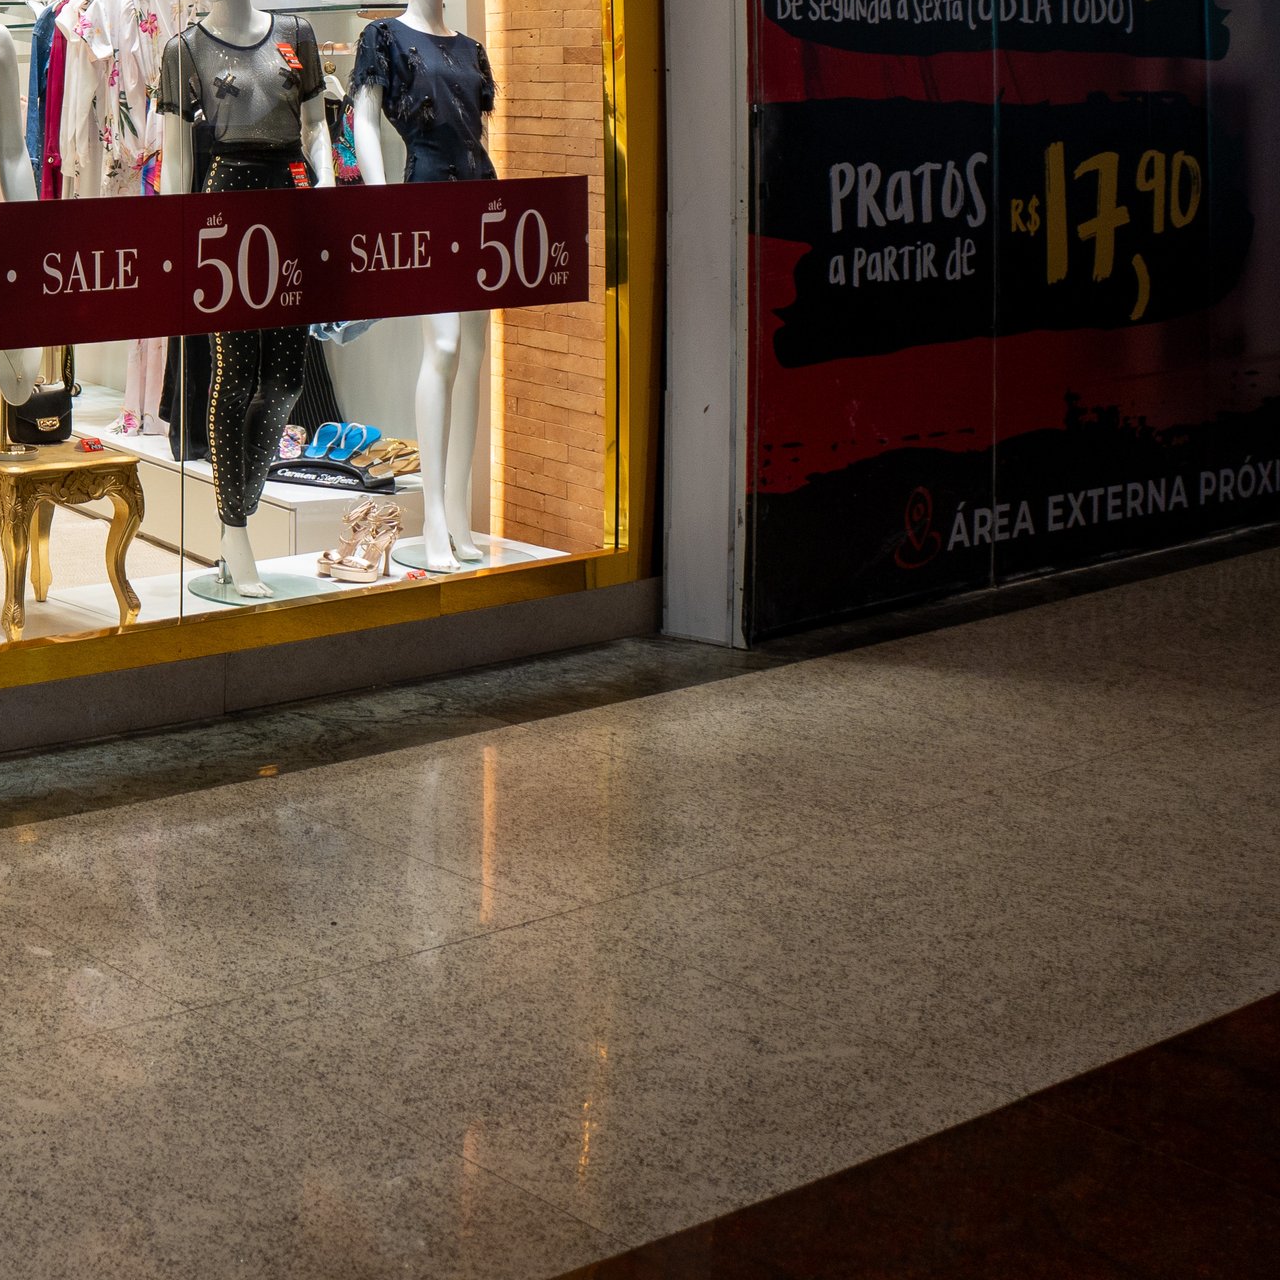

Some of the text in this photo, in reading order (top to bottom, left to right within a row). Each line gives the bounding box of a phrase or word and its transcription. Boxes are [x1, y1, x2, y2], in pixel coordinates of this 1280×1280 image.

[206, 212, 222, 226] até
[488, 198, 503, 211] até
[1009, 194, 1040, 237] R$
[350, 231, 431, 273] SALE
[829, 254, 845, 285] a
[945, 236, 976, 280] de
[42, 249, 139, 295] SALE
[549, 271, 570, 286] OFF
[280, 291, 303, 307] OFF
[277, 468, 317, 481] Carmen
[947, 501, 1036, 551] ÁREA
[1047, 474, 1190, 533] EXTERNA
